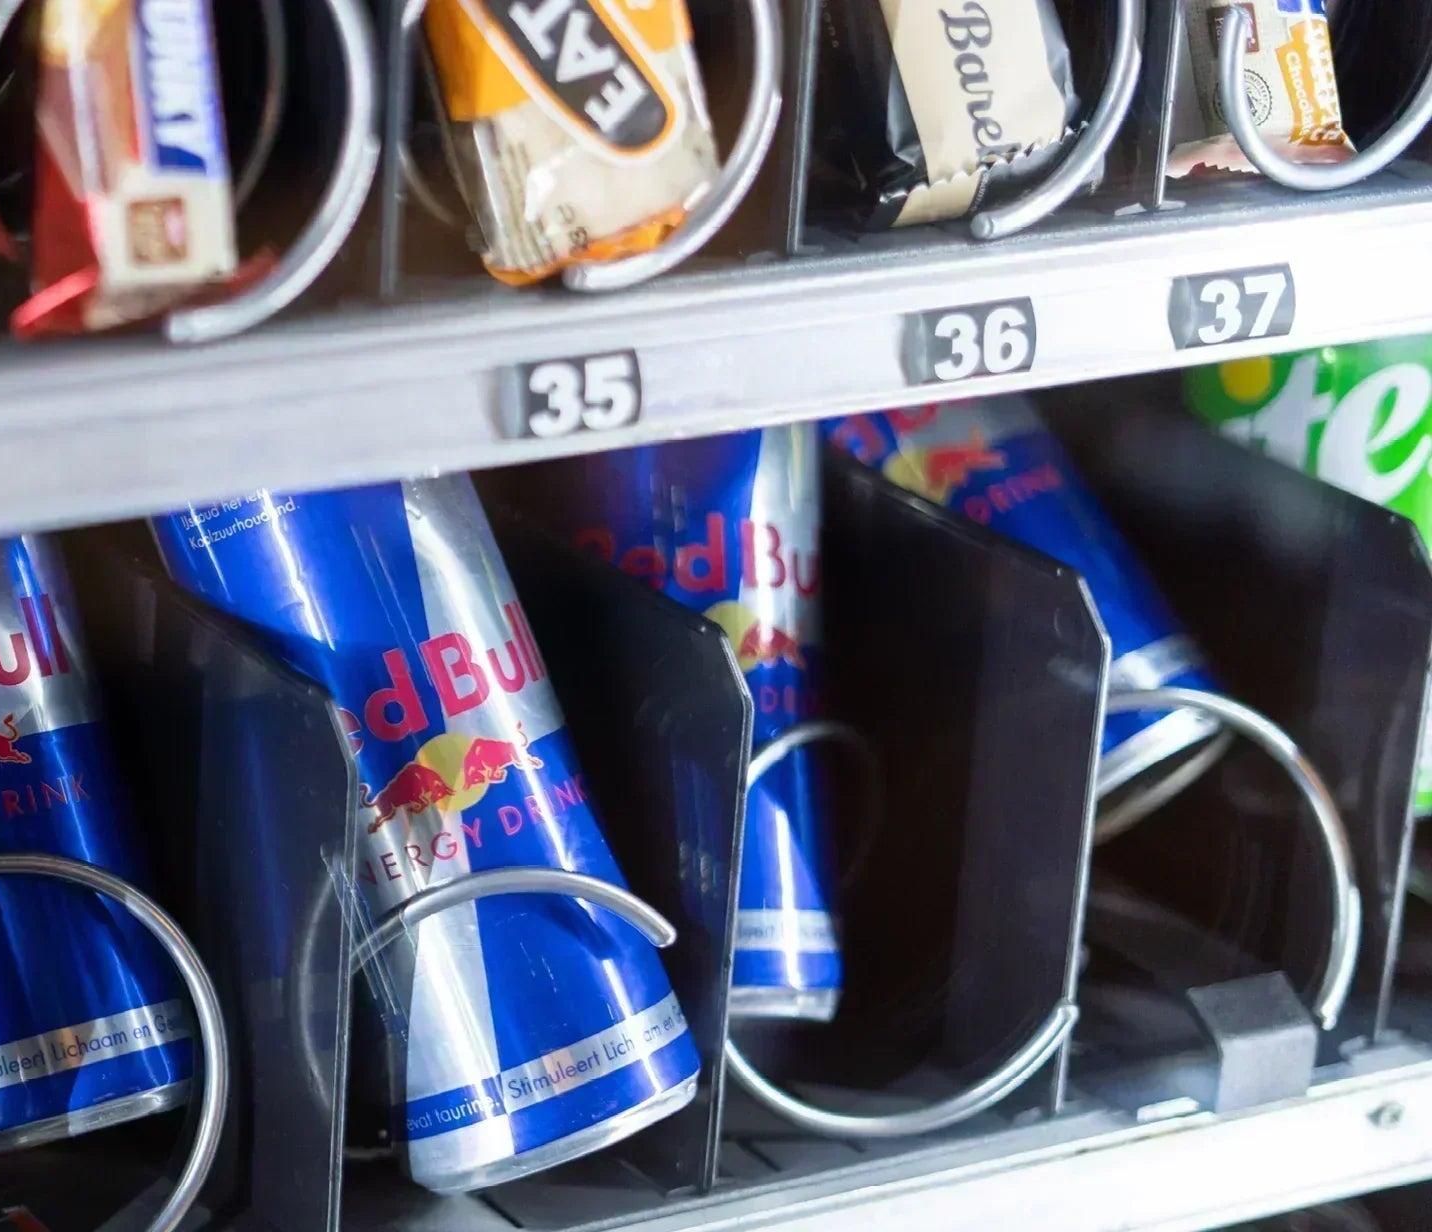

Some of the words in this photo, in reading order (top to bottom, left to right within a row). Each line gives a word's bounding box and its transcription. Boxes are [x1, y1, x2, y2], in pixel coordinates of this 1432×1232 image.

[508, 0, 648, 132] EAT
[933, 306, 1029, 381] 36
[1197, 273, 1287, 344] 37
[528, 353, 637, 438] 35
[1221, 354, 1432, 506] te
[740, 518, 818, 597] Bu
[419, 600, 548, 718] Bull
[497, 774, 588, 836] DRINK
[51, 1029, 129, 1062] Lichaam
[133, 1023, 151, 1040] en
[507, 1051, 601, 1098] Stimuleert
[603, 1024, 660, 1060] Licham
